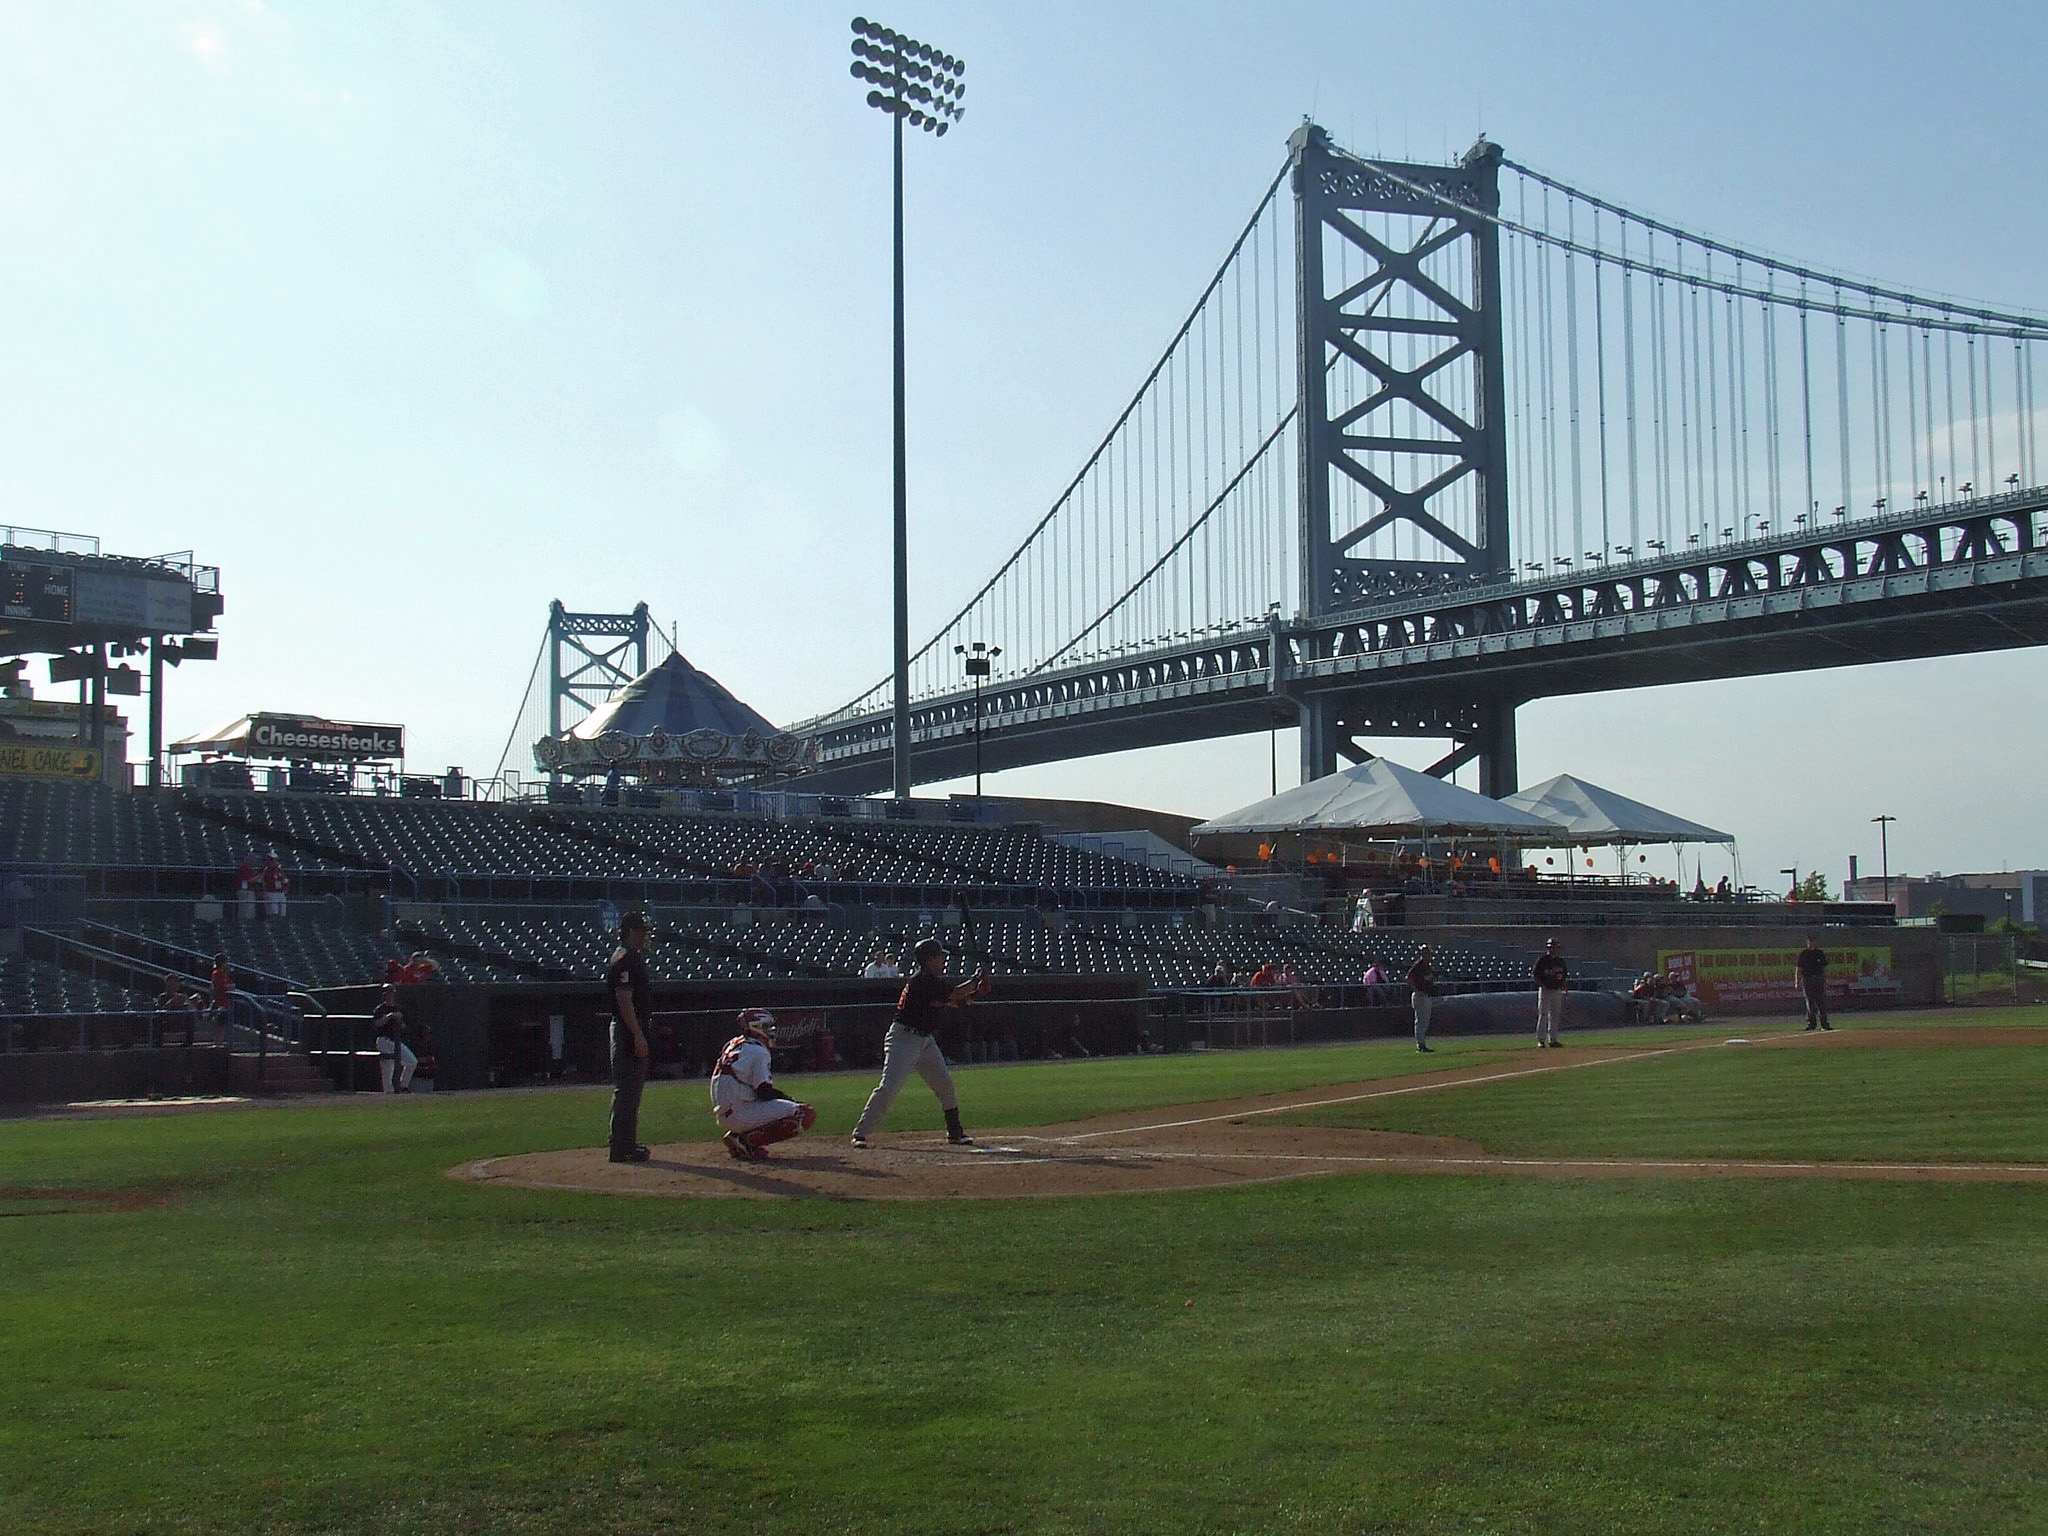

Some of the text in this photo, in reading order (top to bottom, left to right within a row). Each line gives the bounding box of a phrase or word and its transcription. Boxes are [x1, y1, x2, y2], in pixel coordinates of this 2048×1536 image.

[44, 583, 69, 597] HOME
[4, 604, 32, 617] INNING
[256, 726, 396, 753] Cheesesteaks
[33, 751, 72, 773] CAKE
